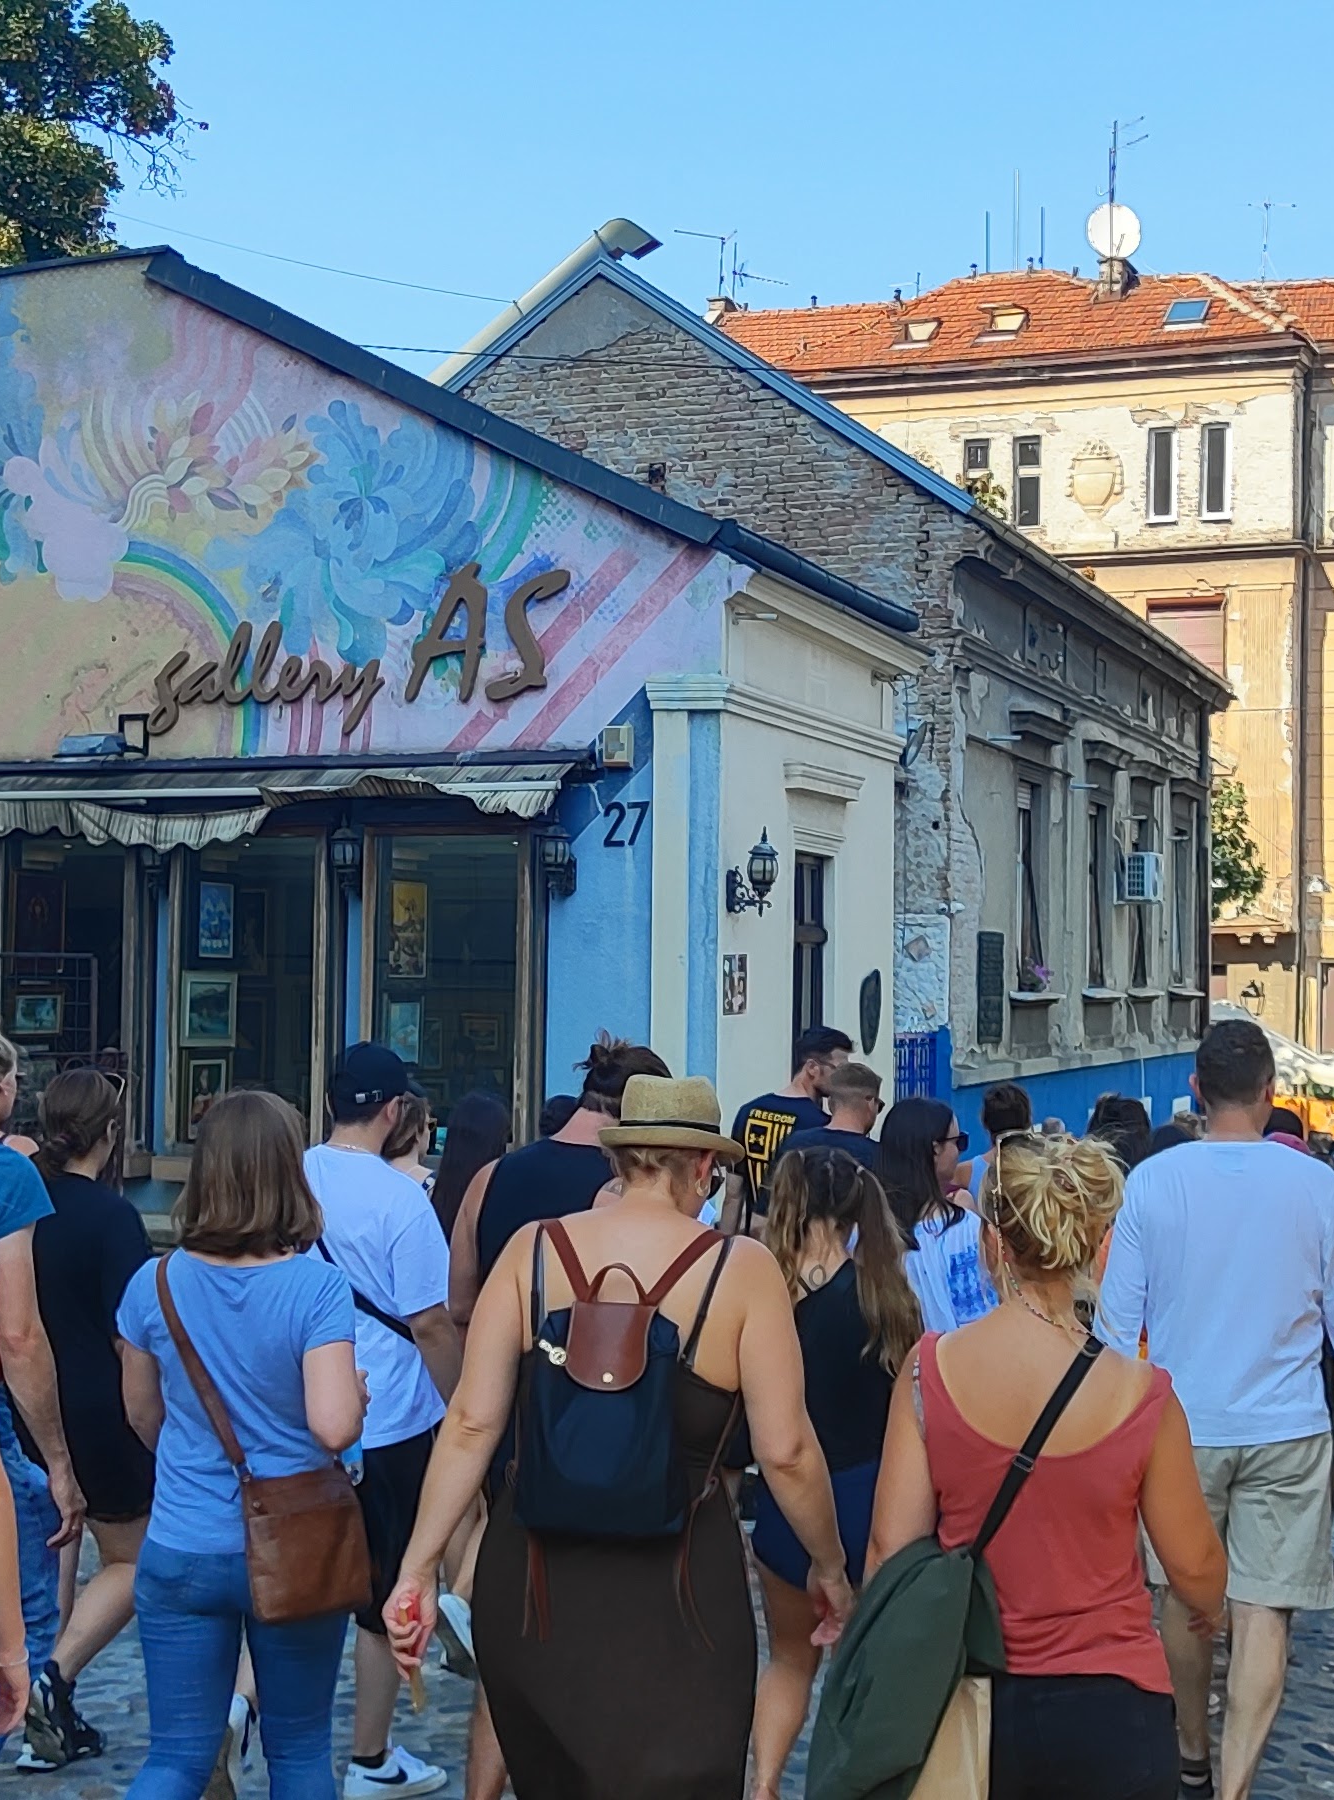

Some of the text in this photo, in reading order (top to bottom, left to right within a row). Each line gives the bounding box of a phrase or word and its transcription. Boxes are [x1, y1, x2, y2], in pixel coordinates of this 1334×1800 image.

[147, 562, 571, 735] gallery AS
[602, 800, 650, 848] 27
[749, 1108, 796, 1124] FREEDOM
